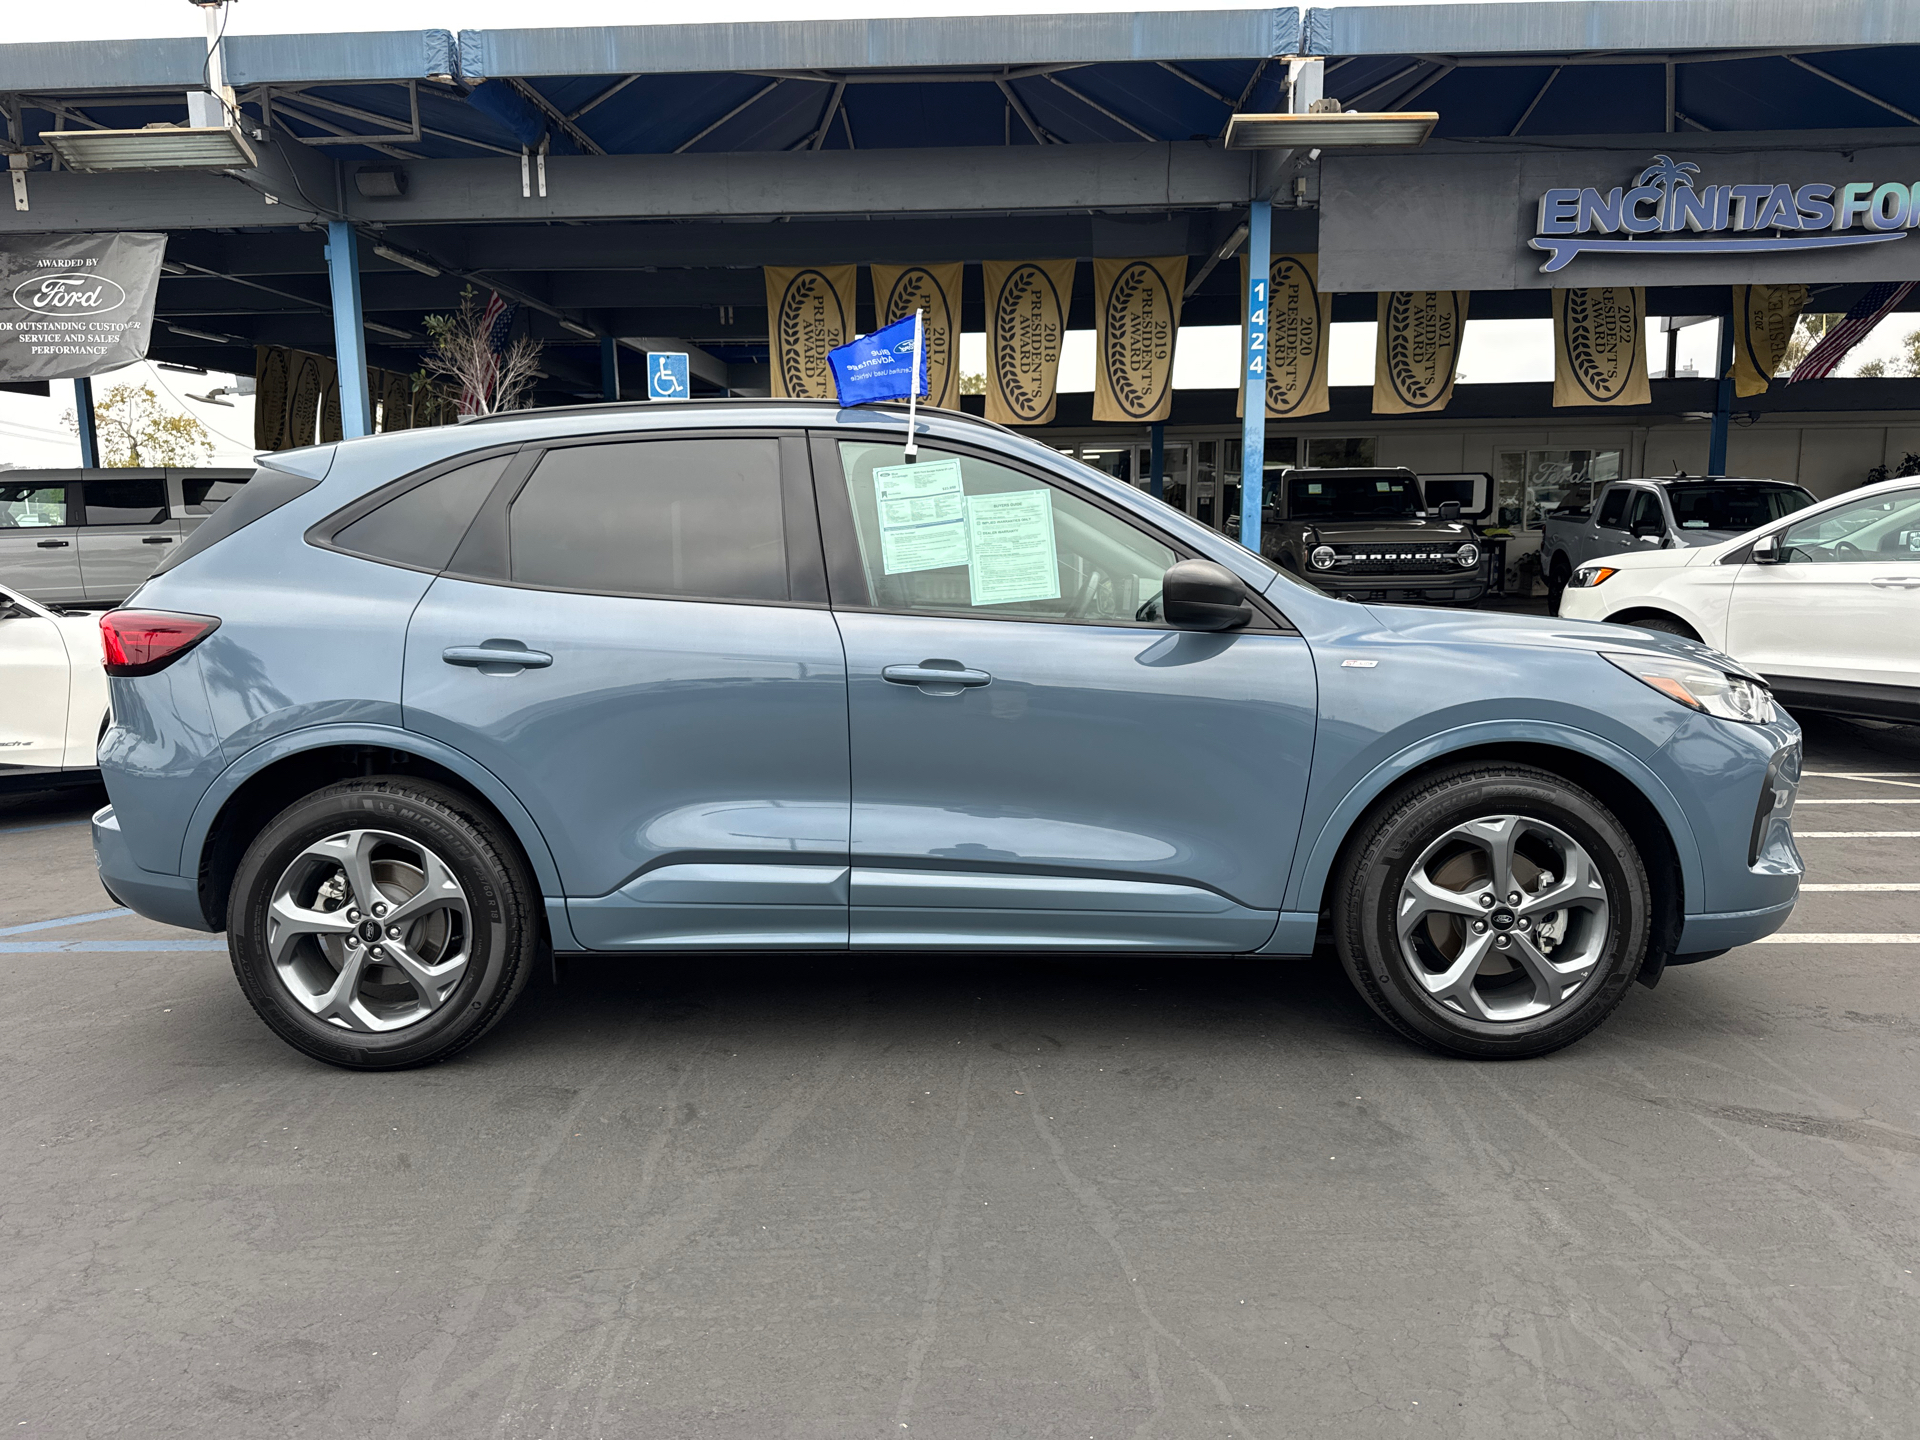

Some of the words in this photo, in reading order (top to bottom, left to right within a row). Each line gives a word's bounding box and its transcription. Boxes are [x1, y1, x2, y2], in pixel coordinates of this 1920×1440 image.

[1539, 182, 1836, 235] ENCINITAS
[36, 258, 84, 268] AWARDED
[86, 258, 99, 267] BY
[33, 278, 103, 308] Ford
[0, 322, 13, 330] OR
[16, 322, 86, 331] OUTSTANDING
[89, 321, 141, 332] CUSTOMER
[19, 334, 62, 343] SERVICE
[64, 334, 85, 343] AND
[88, 334, 120, 343] SALES
[1154, 321, 1168, 360] 2019
[1249, 282, 1266, 374] 1424
[1274, 308, 1286, 368] AWARD
[1287, 283, 1300, 392] PRESIDENT'S
[1300, 317, 1314, 356] 2020
[1412, 305, 1424, 364] AWARD
[1424, 291, 1437, 386] RESIDENT'S
[1438, 312, 1452, 348] 2021
[1591, 298, 1606, 354] AWARD
[1602, 287, 1618, 379] RESIDENT'S
[1618, 305, 1632, 344] 2022
[1754, 310, 1764, 331] 2025
[31, 346, 108, 355] PERFORMANCE
[803, 319, 816, 378] AWARD
[813, 295, 828, 399] PRESIDENT'S
[933, 328, 946, 367] 2017
[1019, 314, 1030, 374] AWARD
[1030, 289, 1042, 398] PRESIDENT'S
[1044, 323, 1056, 363] 2018
[1130, 312, 1141, 372] AWARD
[1141, 287, 1152, 396] PRESIDENT'S
[295, 393, 304, 419] 2022
[326, 400, 338, 424] 2021
[1532, 462, 1587, 484] Ford
[398, 808, 470, 856] MICHELIN
[1406, 790, 1479, 840] MICHELIN
[490, 910, 499, 919] 18
[241, 959, 264, 999] PRIMACY
